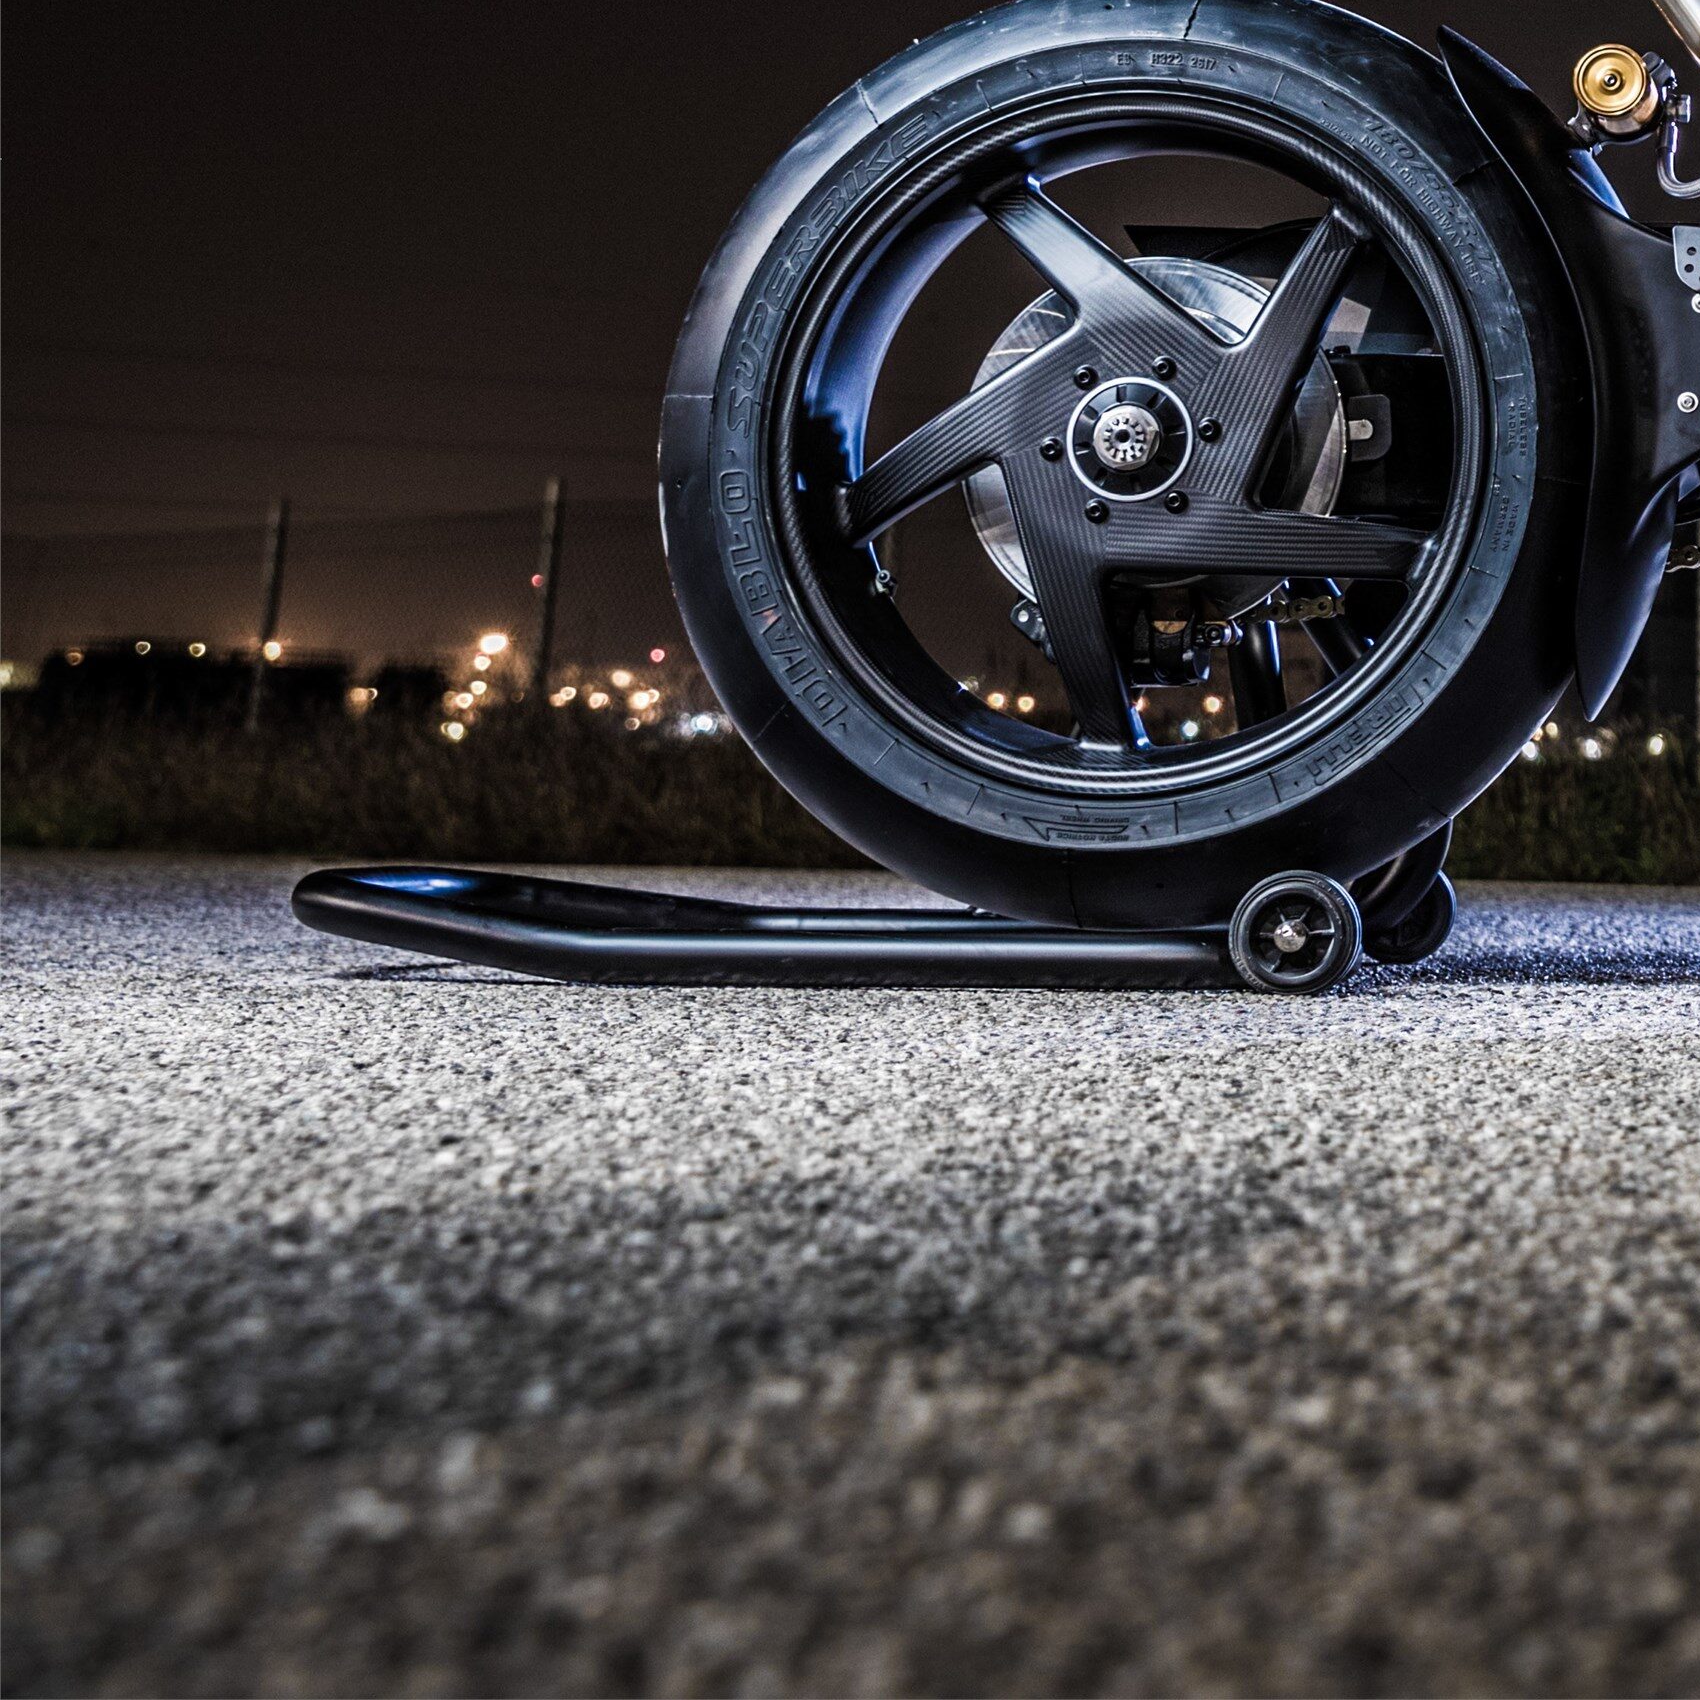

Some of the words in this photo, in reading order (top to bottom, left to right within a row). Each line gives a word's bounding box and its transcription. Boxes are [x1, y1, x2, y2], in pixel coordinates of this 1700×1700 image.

[727, 112, 928, 438] SUPERBIKE
[1360, 134, 1389, 160] NOT
[1389, 159, 1418, 189] FOR
[1416, 188, 1464, 250] HIGHWAY
[720, 469, 849, 727] DIABLO
[1306, 683, 1424, 786] PIRELLI
